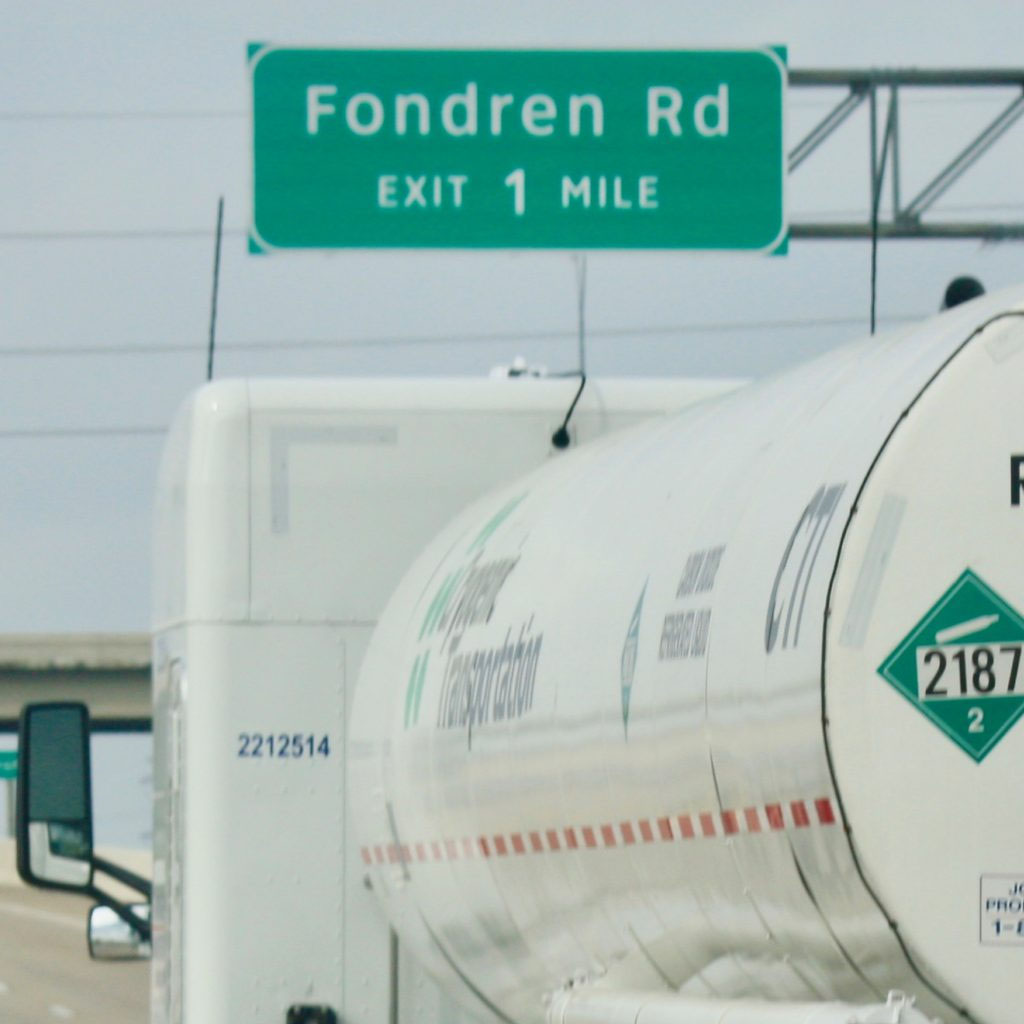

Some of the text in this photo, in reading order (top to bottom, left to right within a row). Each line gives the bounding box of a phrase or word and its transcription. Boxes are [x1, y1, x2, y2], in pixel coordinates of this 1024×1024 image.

[306, 82, 730, 137] Fondren Rd
[377, 168, 659, 216] EXIT 1 MILE
[922, 647, 1023, 697] 2187
[966, 706, 985, 734] 2
[236, 733, 331, 758] 2212514
